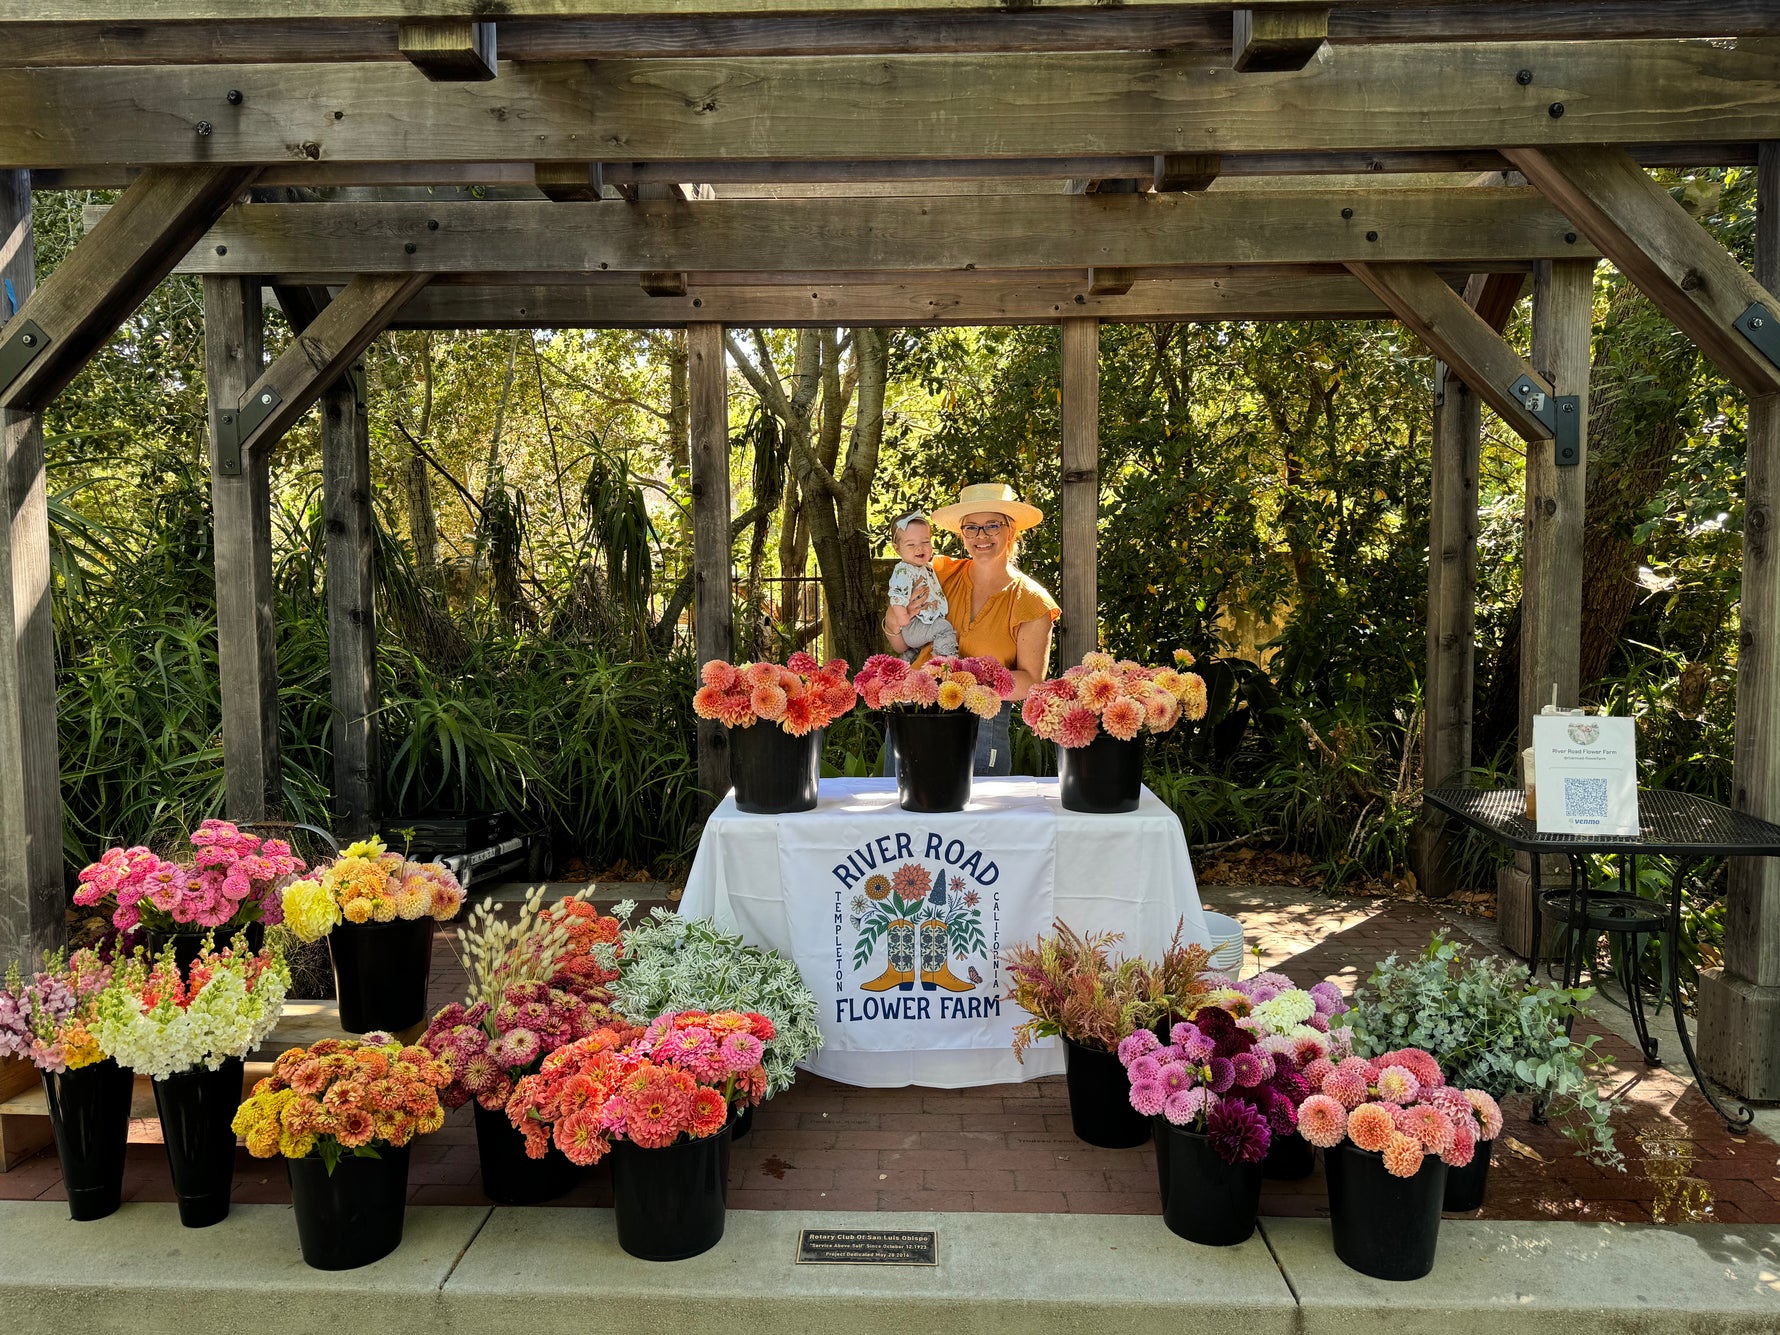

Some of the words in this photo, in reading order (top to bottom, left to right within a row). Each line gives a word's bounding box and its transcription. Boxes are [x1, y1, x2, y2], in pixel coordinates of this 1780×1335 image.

[832, 832, 914, 890] RIVER
[924, 832, 1000, 886] ROAD
[834, 891, 844, 993] TEMPLETON
[992, 891, 1000, 989] CALIFORNIA
[836, 996, 931, 1023] FLOWER
[940, 995, 1000, 1019] FARM
